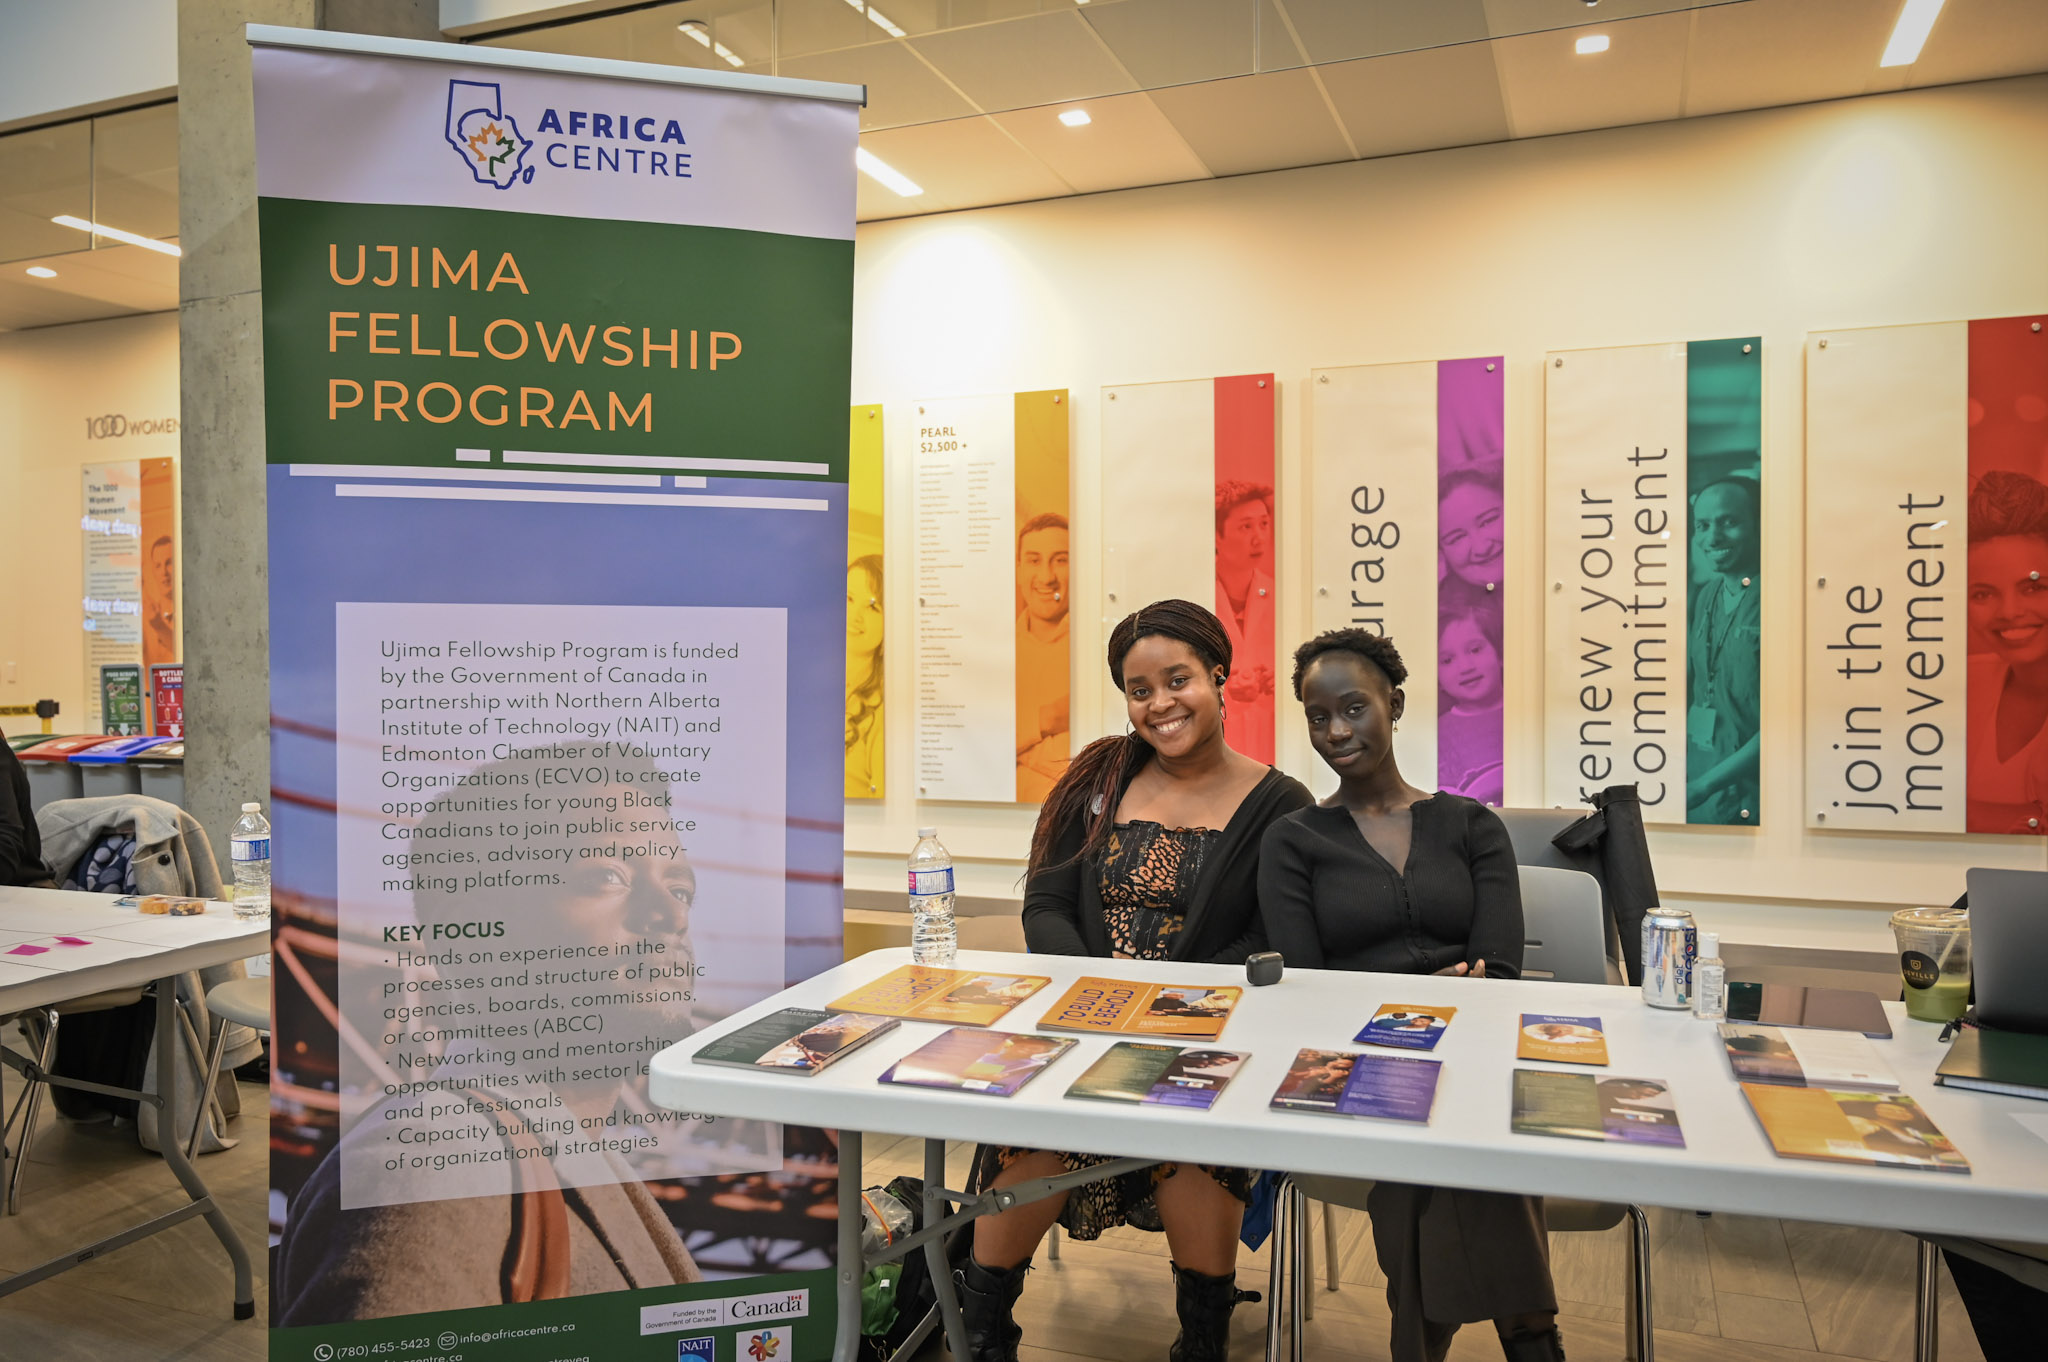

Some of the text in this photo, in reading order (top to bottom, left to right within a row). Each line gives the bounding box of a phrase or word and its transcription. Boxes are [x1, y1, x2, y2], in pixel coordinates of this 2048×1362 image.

[537, 108, 687, 146] AFRICA
[545, 142, 693, 178] CENTRE
[328, 243, 530, 295] UJIMA
[328, 311, 743, 371] FELLOWSHIP
[328, 378, 654, 433] PROGRAM
[921, 427, 956, 438] PEARL
[921, 441, 958, 453] $2,500
[1350, 486, 1400, 639] urage
[1579, 488, 1628, 613] your
[1622, 446, 1667, 806] commitment
[381, 640, 738, 663] Ujima Fellowship Program is funded
[1900, 493, 1944, 812] movement
[381, 666, 707, 688] by the Government of Canada in
[381, 691, 720, 714] partnership with Northern Alberta
[1826, 585, 1898, 814] join the
[382, 716, 720, 737] Institute of Technology (NAIT) and
[382, 741, 711, 762] Edmonton Chamber of Voluntary
[381, 767, 701, 792] Organizations (ECVO) to create
[381, 790, 672, 818] opportunities for young Black
[381, 817, 696, 840] Canadians to join public service
[382, 840, 687, 870] agencies, advisory and policy-
[383, 869, 566, 893] making platforms.
[382, 921, 505, 942] KEY FOCUS
[398, 939, 665, 967] Hands on experience in the
[384, 961, 705, 998] processes and structure of public
[383, 990, 696, 1024] agencies, boards, commissions,
[1058, 989, 1104, 1022] TO BUILD
[1094, 989, 1134, 1018] BEHOLD
[384, 1014, 603, 1044] or committees (ABCC)
[398, 1047, 515, 1069] Networking
[522, 1041, 559, 1060] and
[383, 1074, 519, 1098] opportunities
[525, 1066, 566, 1084] with
[572, 1065, 630, 1081] sector
[384, 1092, 562, 1120] and professionals
[397, 1125, 489, 1146] Capacity
[496, 1117, 574, 1138] building
[580, 1110, 619, 1129] and
[385, 1136, 658, 1171] of organizational strategies
[672, 1309, 696, 1318] Funded
[698, 1309, 705, 1318] by
[731, 1295, 802, 1319] Canada
[645, 1315, 717, 1330] Government of Canada
[337, 1345, 369, 1360] (780)
[372, 1337, 430, 1354] 455-5423
[460, 1322, 575, 1343] info@africacentre.ca
[681, 1339, 711, 1351] NAIT
